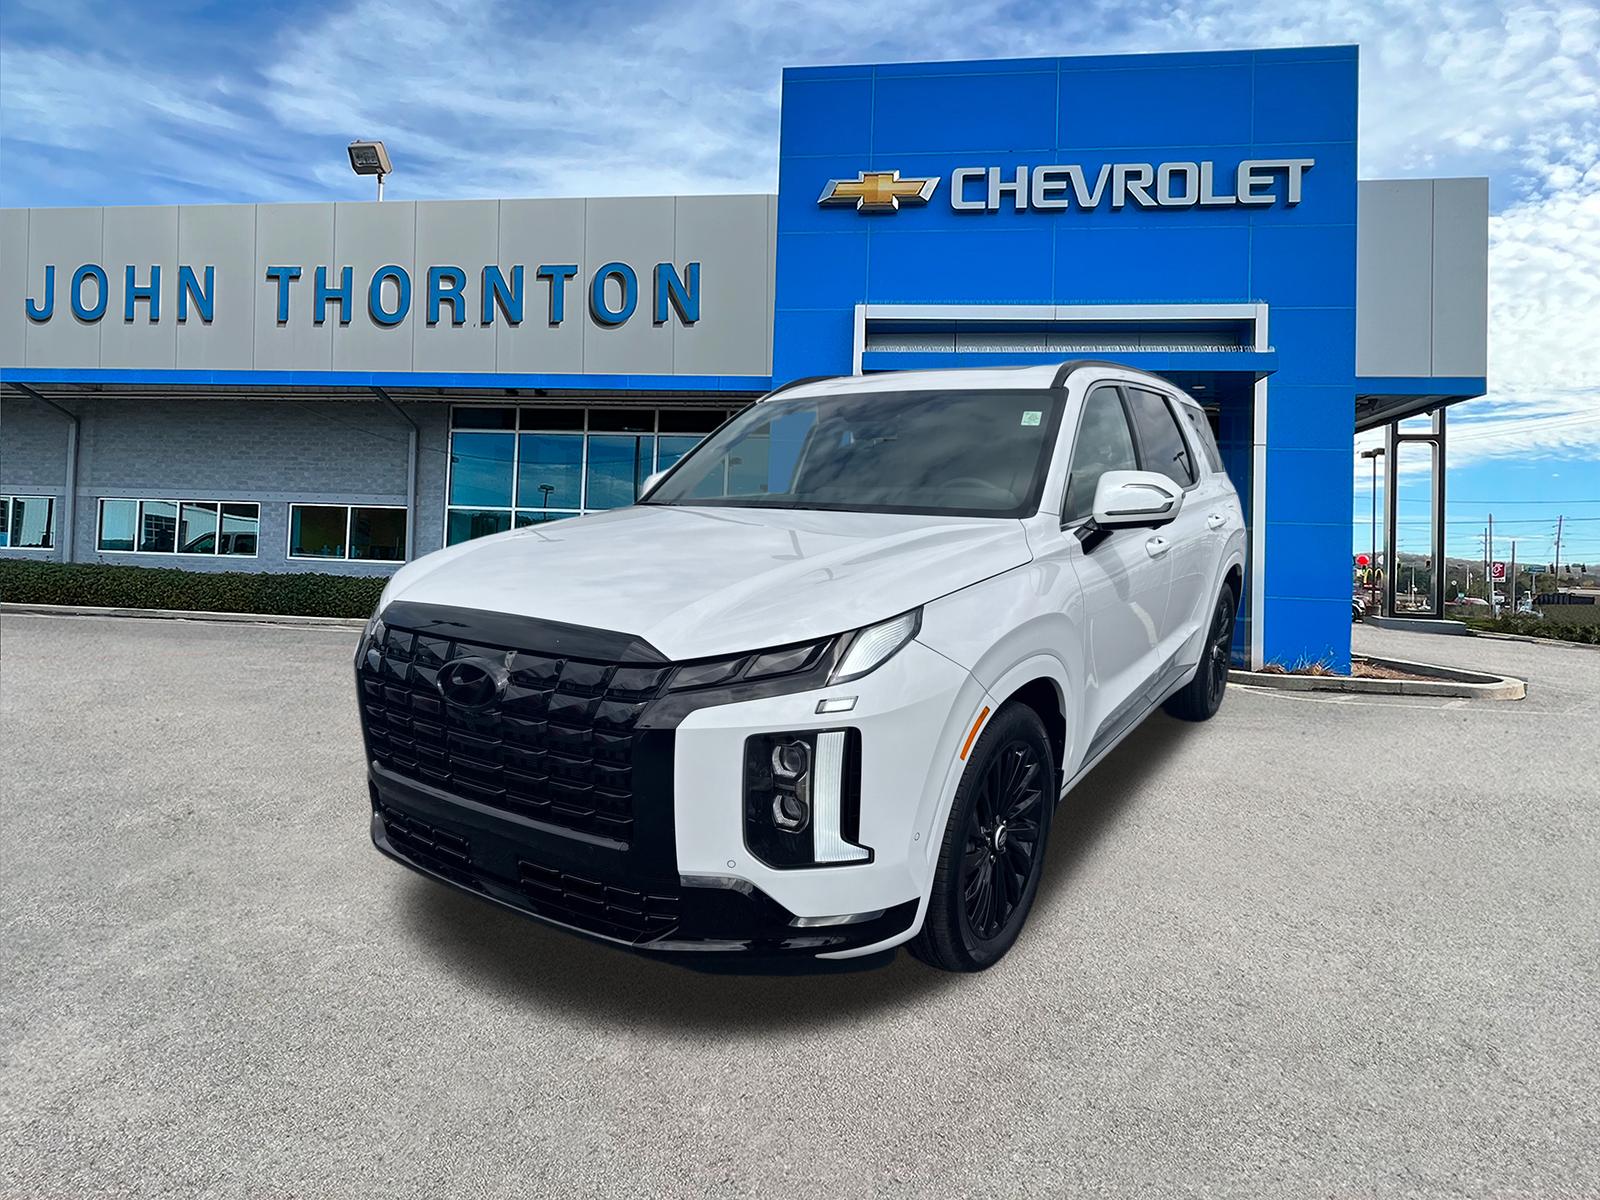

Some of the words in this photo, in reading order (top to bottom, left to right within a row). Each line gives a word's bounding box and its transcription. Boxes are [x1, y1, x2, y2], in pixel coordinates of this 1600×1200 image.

[950, 158, 1315, 212] CHEVROLET
[26, 263, 215, 322] JOHN
[266, 261, 701, 326] THORNTON
